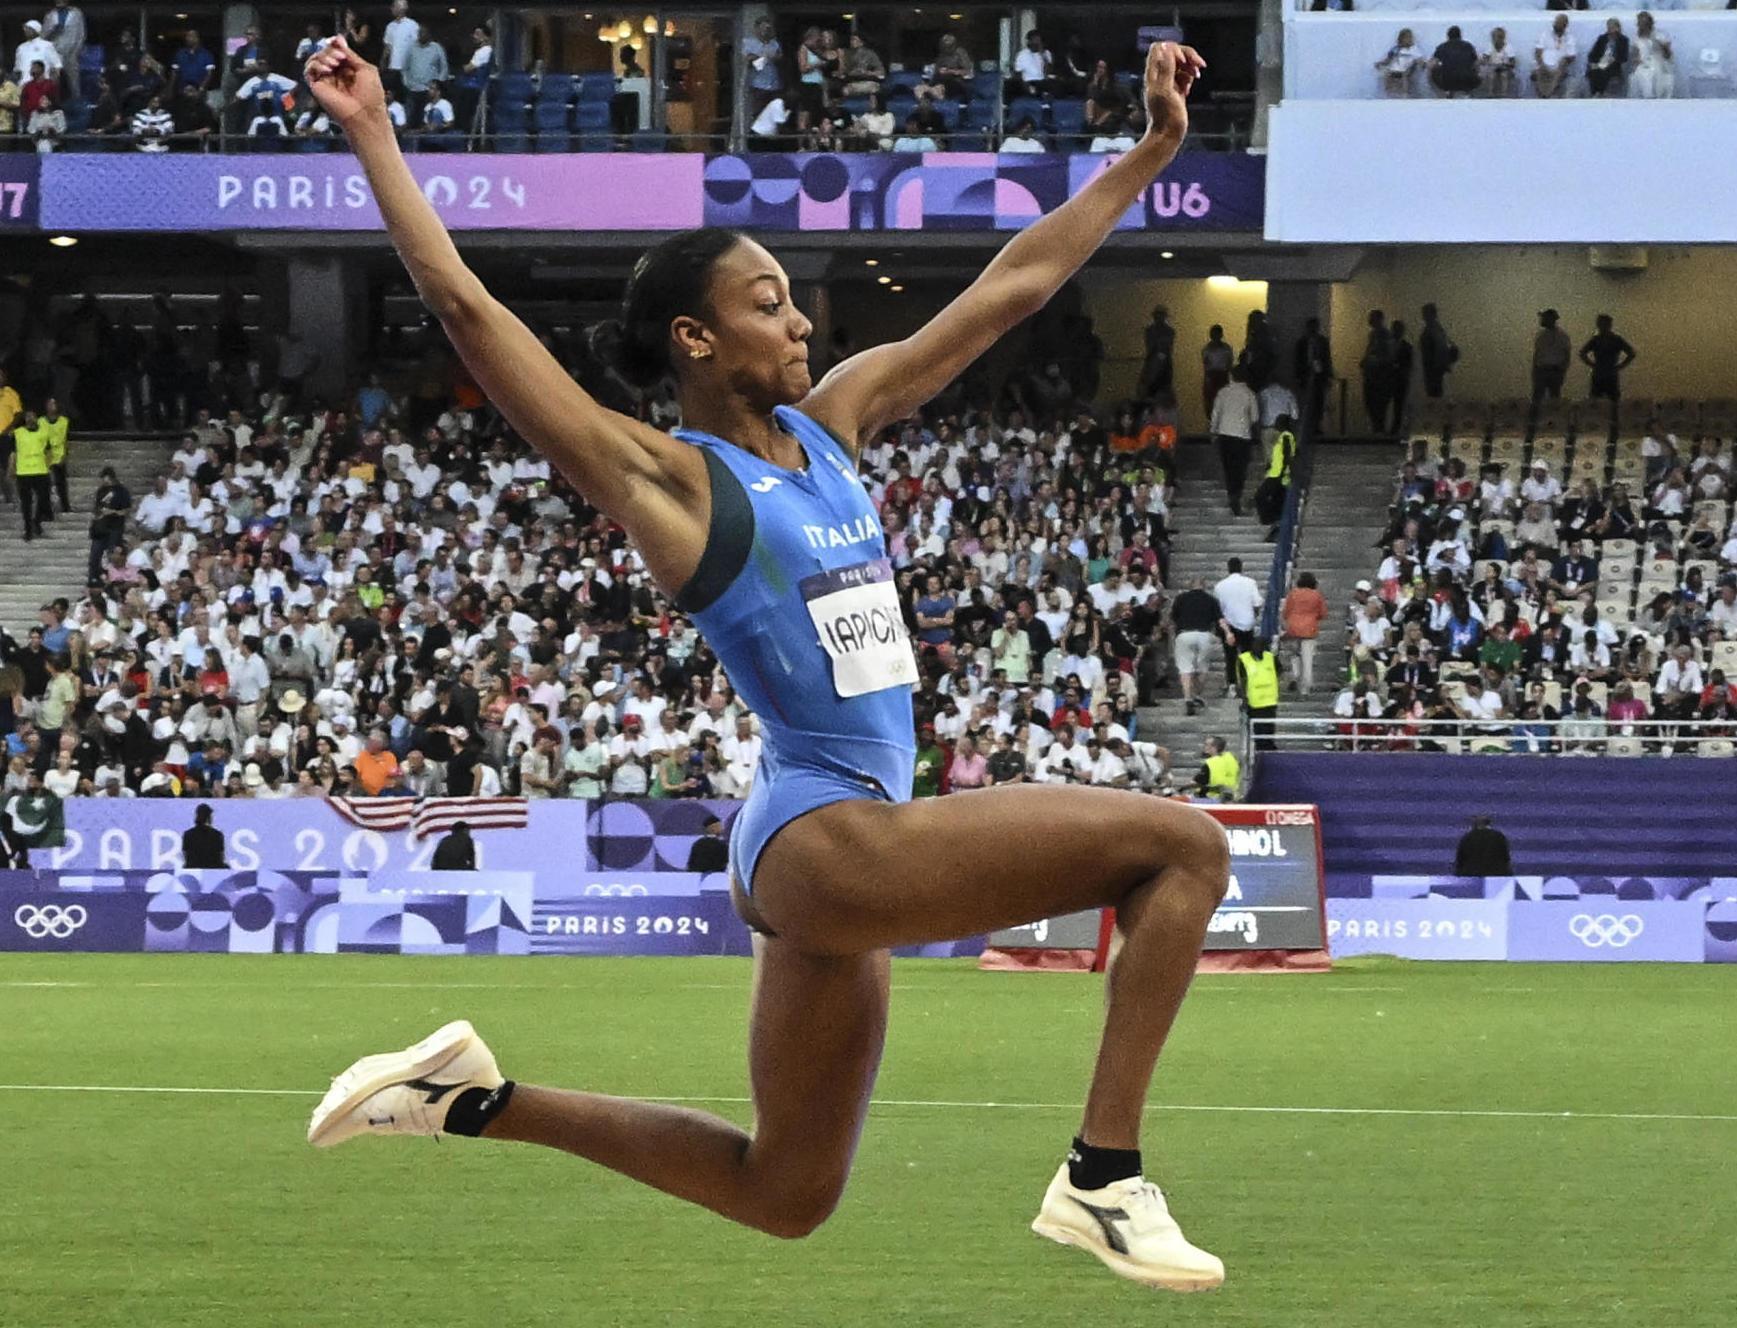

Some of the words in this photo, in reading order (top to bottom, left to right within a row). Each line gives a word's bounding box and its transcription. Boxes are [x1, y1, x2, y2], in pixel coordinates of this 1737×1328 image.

[0, 182, 29, 218] 7
[424, 175, 525, 208] 024
[1153, 182, 1211, 217] U6
[803, 514, 880, 549] ITALIA
[52, 829, 260, 871] PARS
[295, 829, 483, 872] 202
[636, 916, 709, 934] 2024
[1418, 919, 1493, 938] 2024
